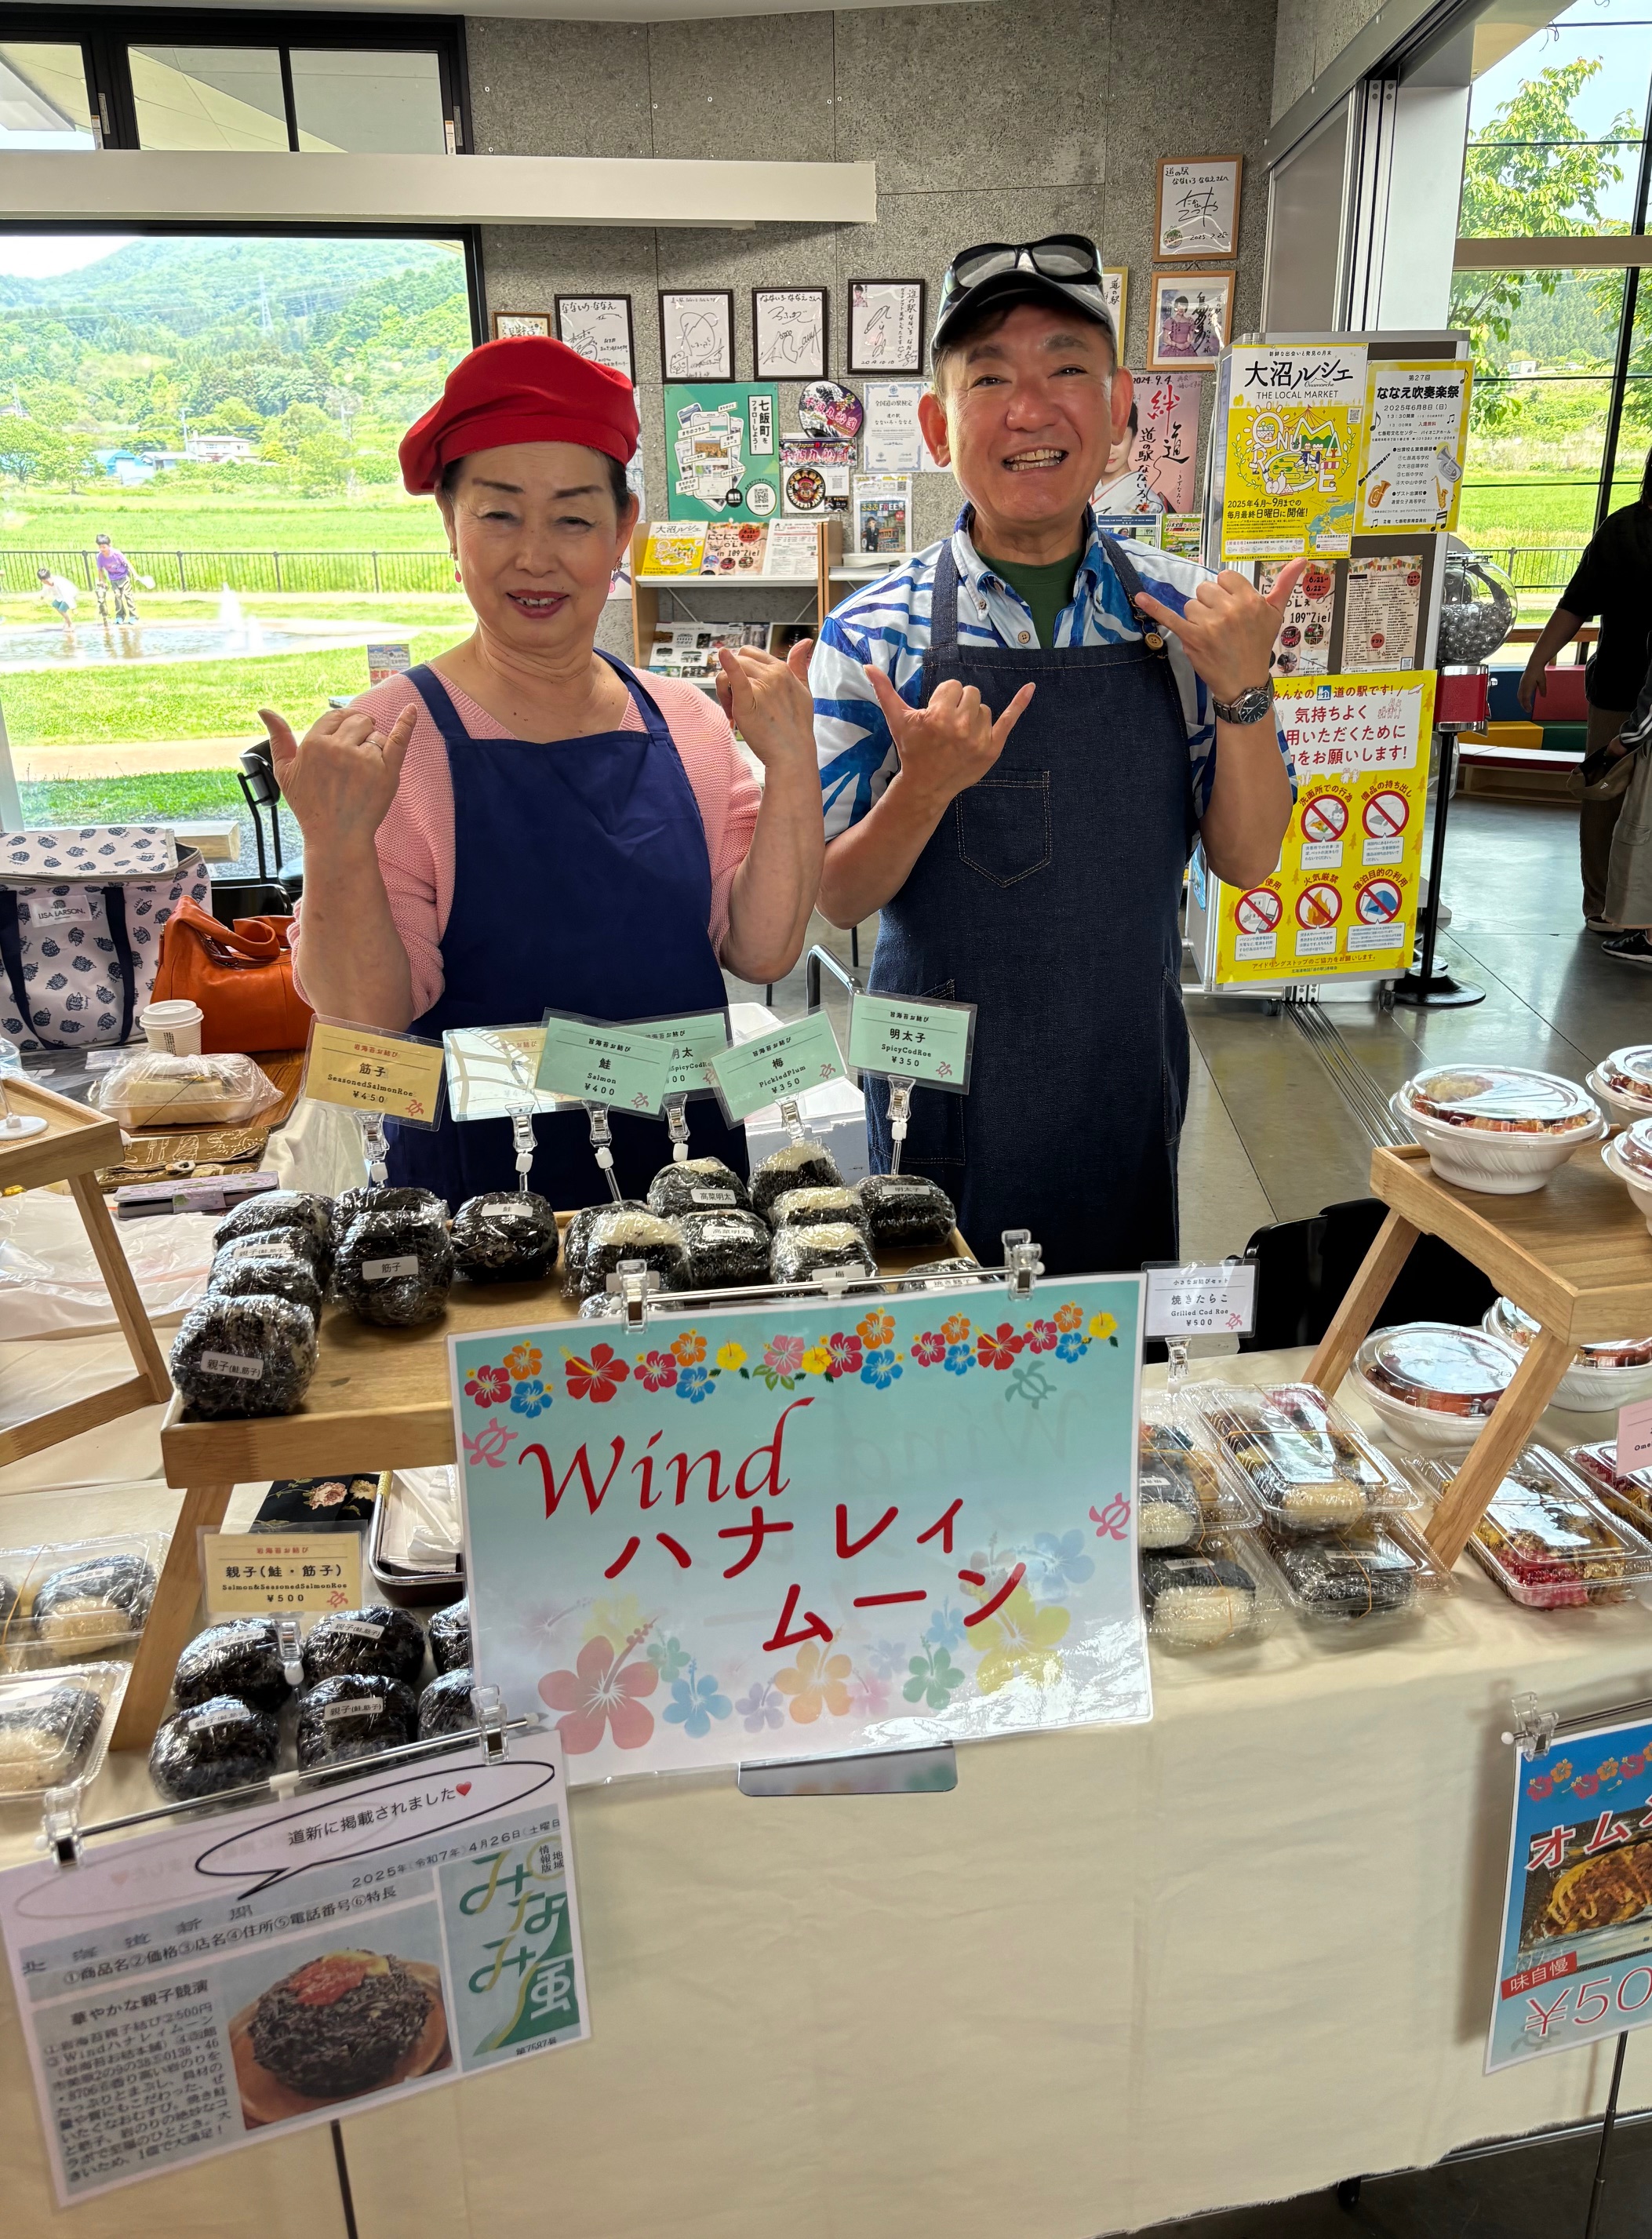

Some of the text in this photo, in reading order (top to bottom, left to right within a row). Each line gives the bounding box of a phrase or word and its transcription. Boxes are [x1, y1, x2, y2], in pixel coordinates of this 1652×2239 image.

[1165, 167, 1189, 177] 道の駅
[1244, 359, 1353, 390] 大沼ルシェ
[1305, 390, 1338, 399] MARKET
[1377, 385, 1459, 399] ななえ吹奏楽祭
[759, 399, 770, 444] 七飯町を
[1148, 384, 1191, 464] 絆 道
[1135, 427, 1156, 462] 道の駅
[656, 525, 701, 533] 大沼ルシェ
[1334, 685, 1393, 697] 道の駅です!
[1294, 704, 1367, 724] 気持ちよく
[1291, 745, 1406, 766] をお願いします!
[1299, 785, 1353, 806] 洗面所での行為
[1362, 779, 1412, 801] 備品の持ち出し
[1304, 872, 1339, 886] 火気厳禁
[1353, 868, 1408, 891] 宿泊目的の利用
[890, 1028, 926, 1043] 明太子
[882, 1043, 932, 1058] SpicyCodRoe
[599, 1058, 611, 1070] 鮭
[773, 1058, 784, 1069] 梅
[892, 1056, 920, 1067] ¥350
[359, 1062, 386, 1077] 筋子
[759, 1065, 806, 1088] PickledPlum
[588, 1072, 617, 1084] Salmon
[584, 1083, 615, 1096] ¥400
[772, 1078, 801, 1094] ¥350
[353, 1090, 385, 1103] ¥450
[700, 1192, 733, 1201] 高菜明太
[894, 1185, 922, 1194] 明太子
[381, 1261, 402, 1274] 筋子
[1171, 1294, 1228, 1305] 焼きたらこ
[518, 1397, 816, 1520] Wind
[267, 1593, 305, 1603] ¥500
[763, 1562, 1025, 1652] ムーン
[288, 1786, 457, 1847] 道新に掲載されました
[539, 1845, 564, 1873] 地域 情報版
[1510, 1957, 1569, 1991] 味自慢
